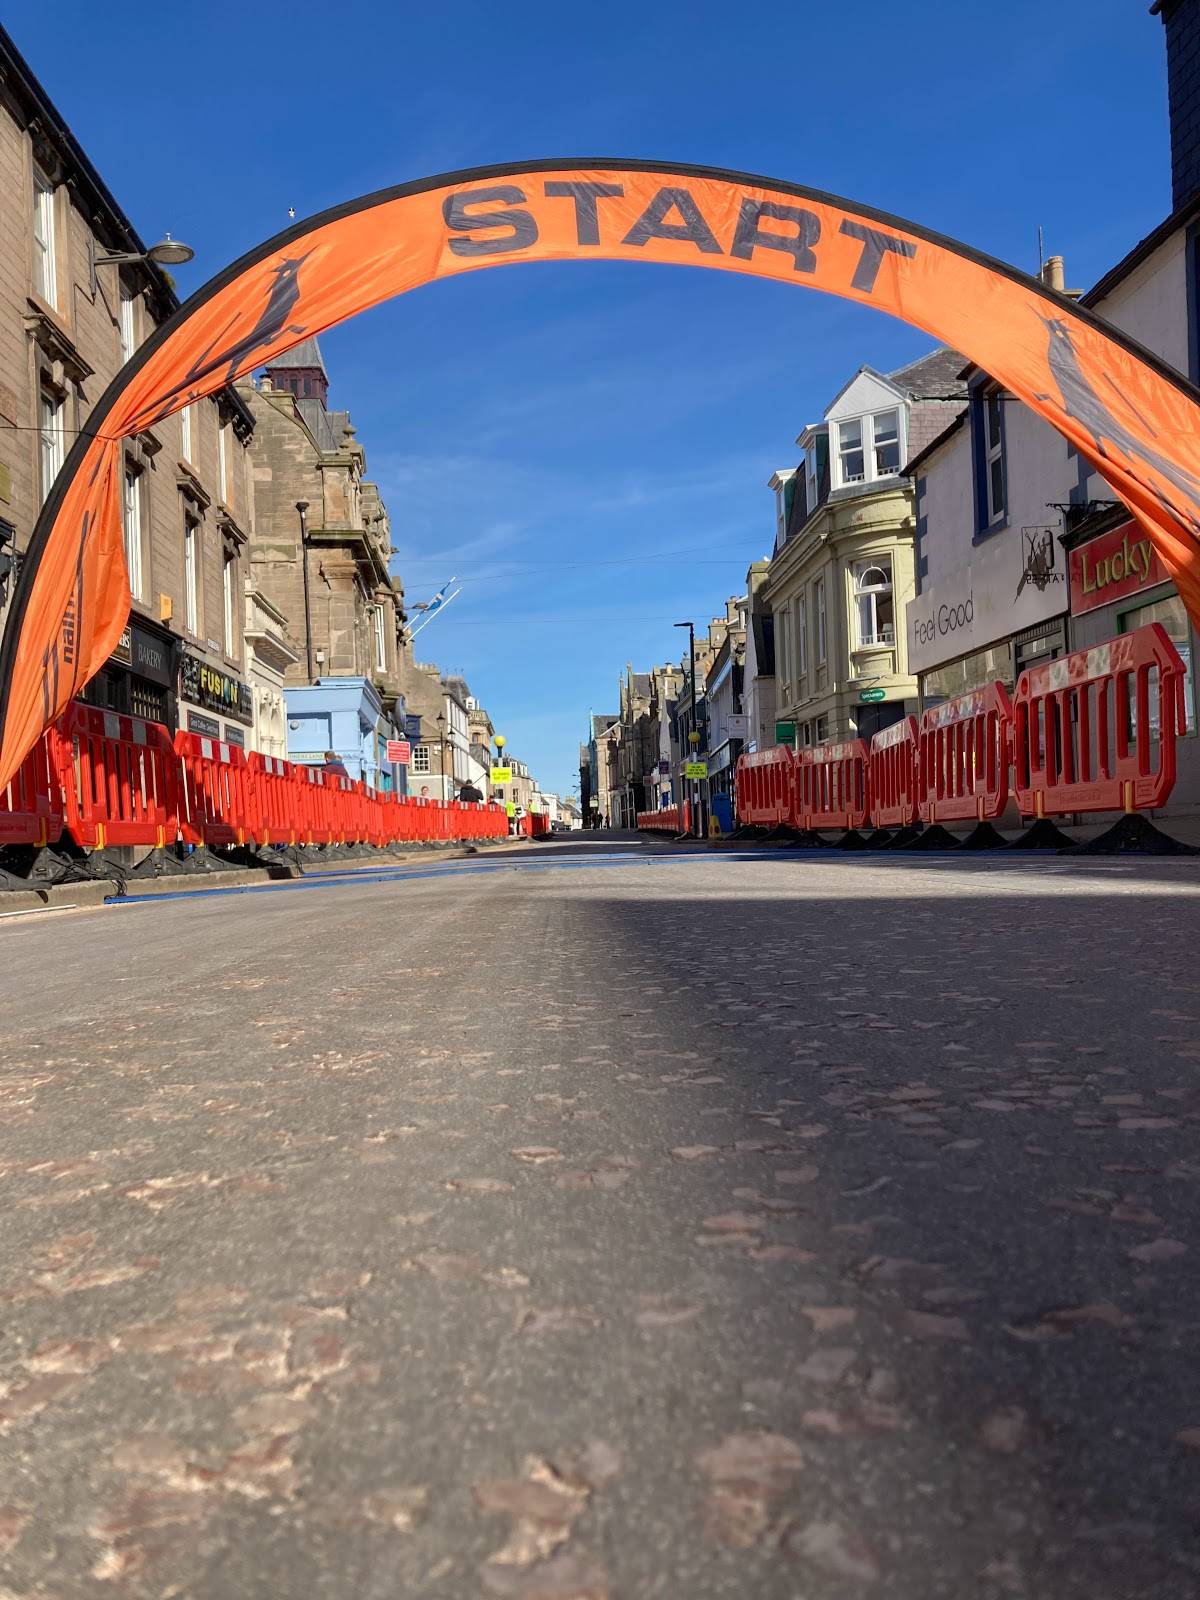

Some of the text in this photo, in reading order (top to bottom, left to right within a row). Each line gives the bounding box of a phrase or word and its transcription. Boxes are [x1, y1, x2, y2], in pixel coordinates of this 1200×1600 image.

[442, 181, 917, 293] START
[1080, 533, 1152, 594] Lucky
[914, 588, 975, 649] Feel Good
[138, 643, 162, 670] BAKERY
